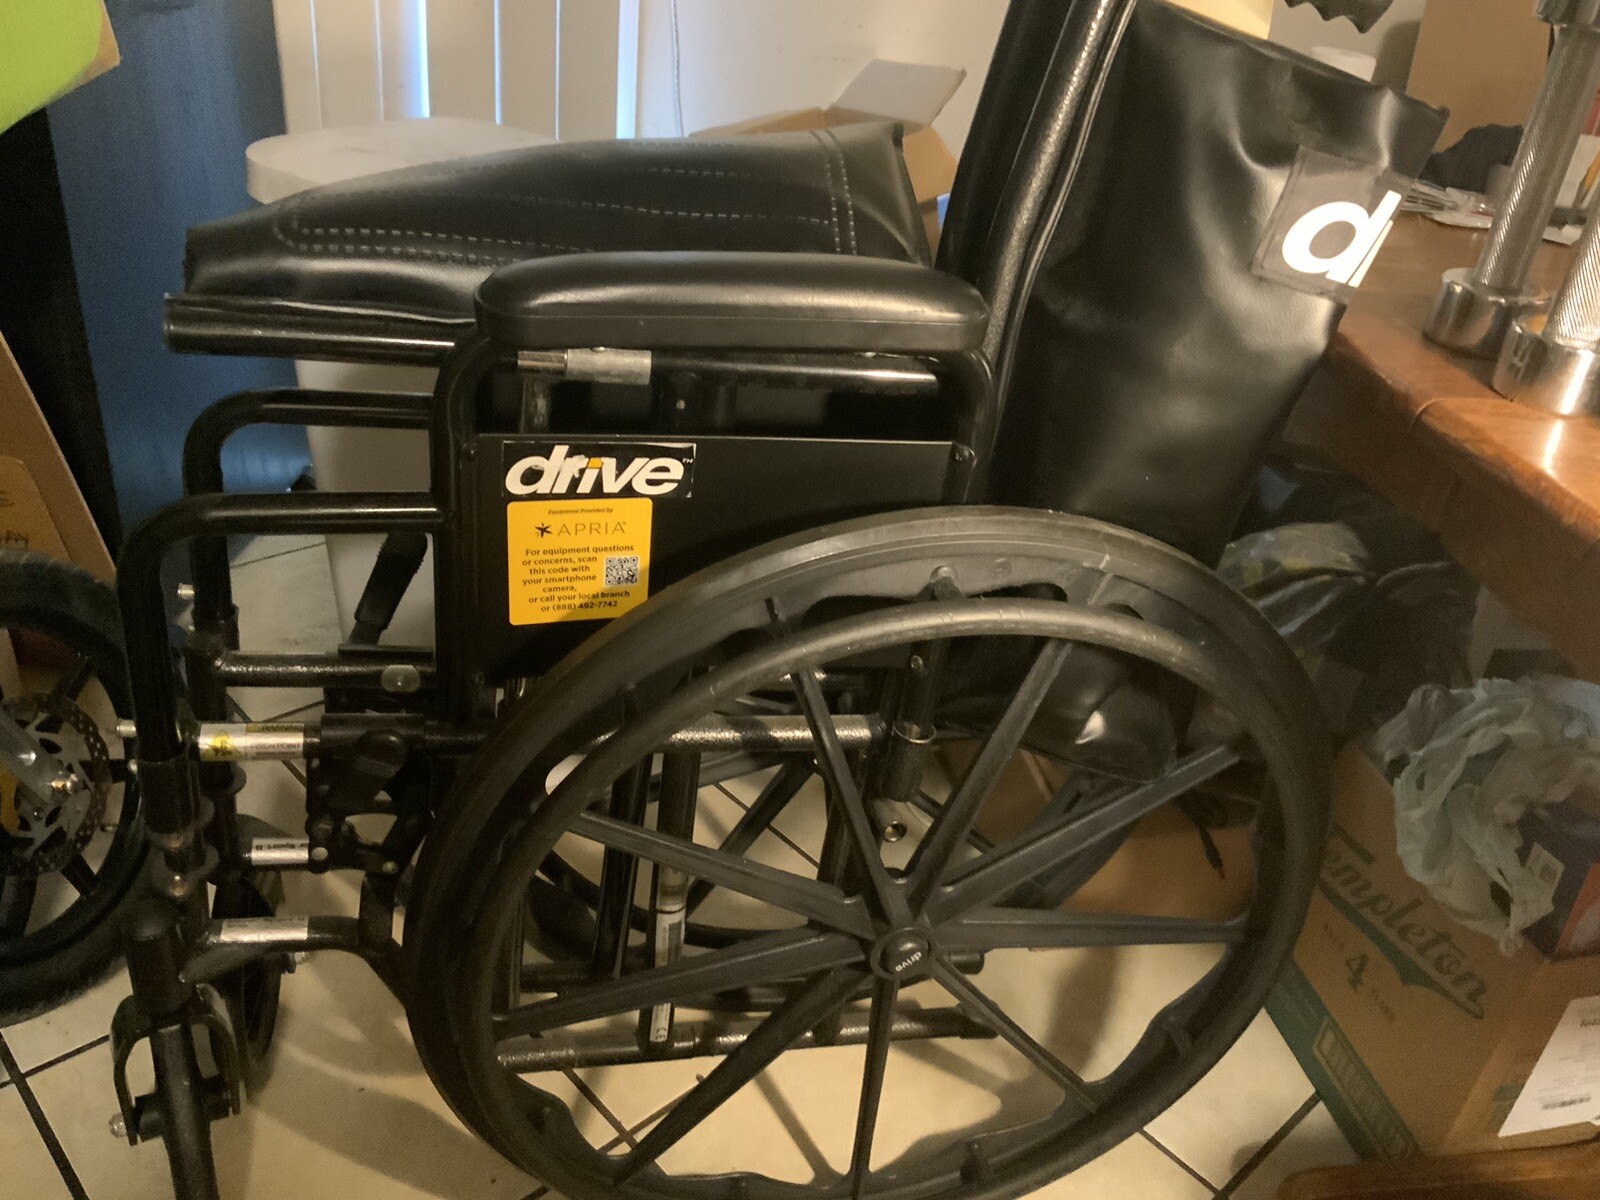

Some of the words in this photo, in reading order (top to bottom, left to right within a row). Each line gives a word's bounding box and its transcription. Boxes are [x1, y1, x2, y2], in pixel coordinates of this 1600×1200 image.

[543, 546, 590, 557] equipment
[592, 545, 634, 553] questions
[534, 558, 576, 566] concerns,
[529, 567, 546, 575] this
[548, 566, 570, 574] code
[571, 565, 590, 573] with
[522, 577, 542, 586] your
[544, 574, 597, 585] smartphone
[542, 585, 577, 593] camera,
[557, 593, 576, 602] your
[579, 592, 599, 600] local
[601, 590, 630, 599] branch
[552, 602, 577, 612] (888)
[578, 600, 618, 609] 492-7742
[1345, 953, 1370, 993] 4
